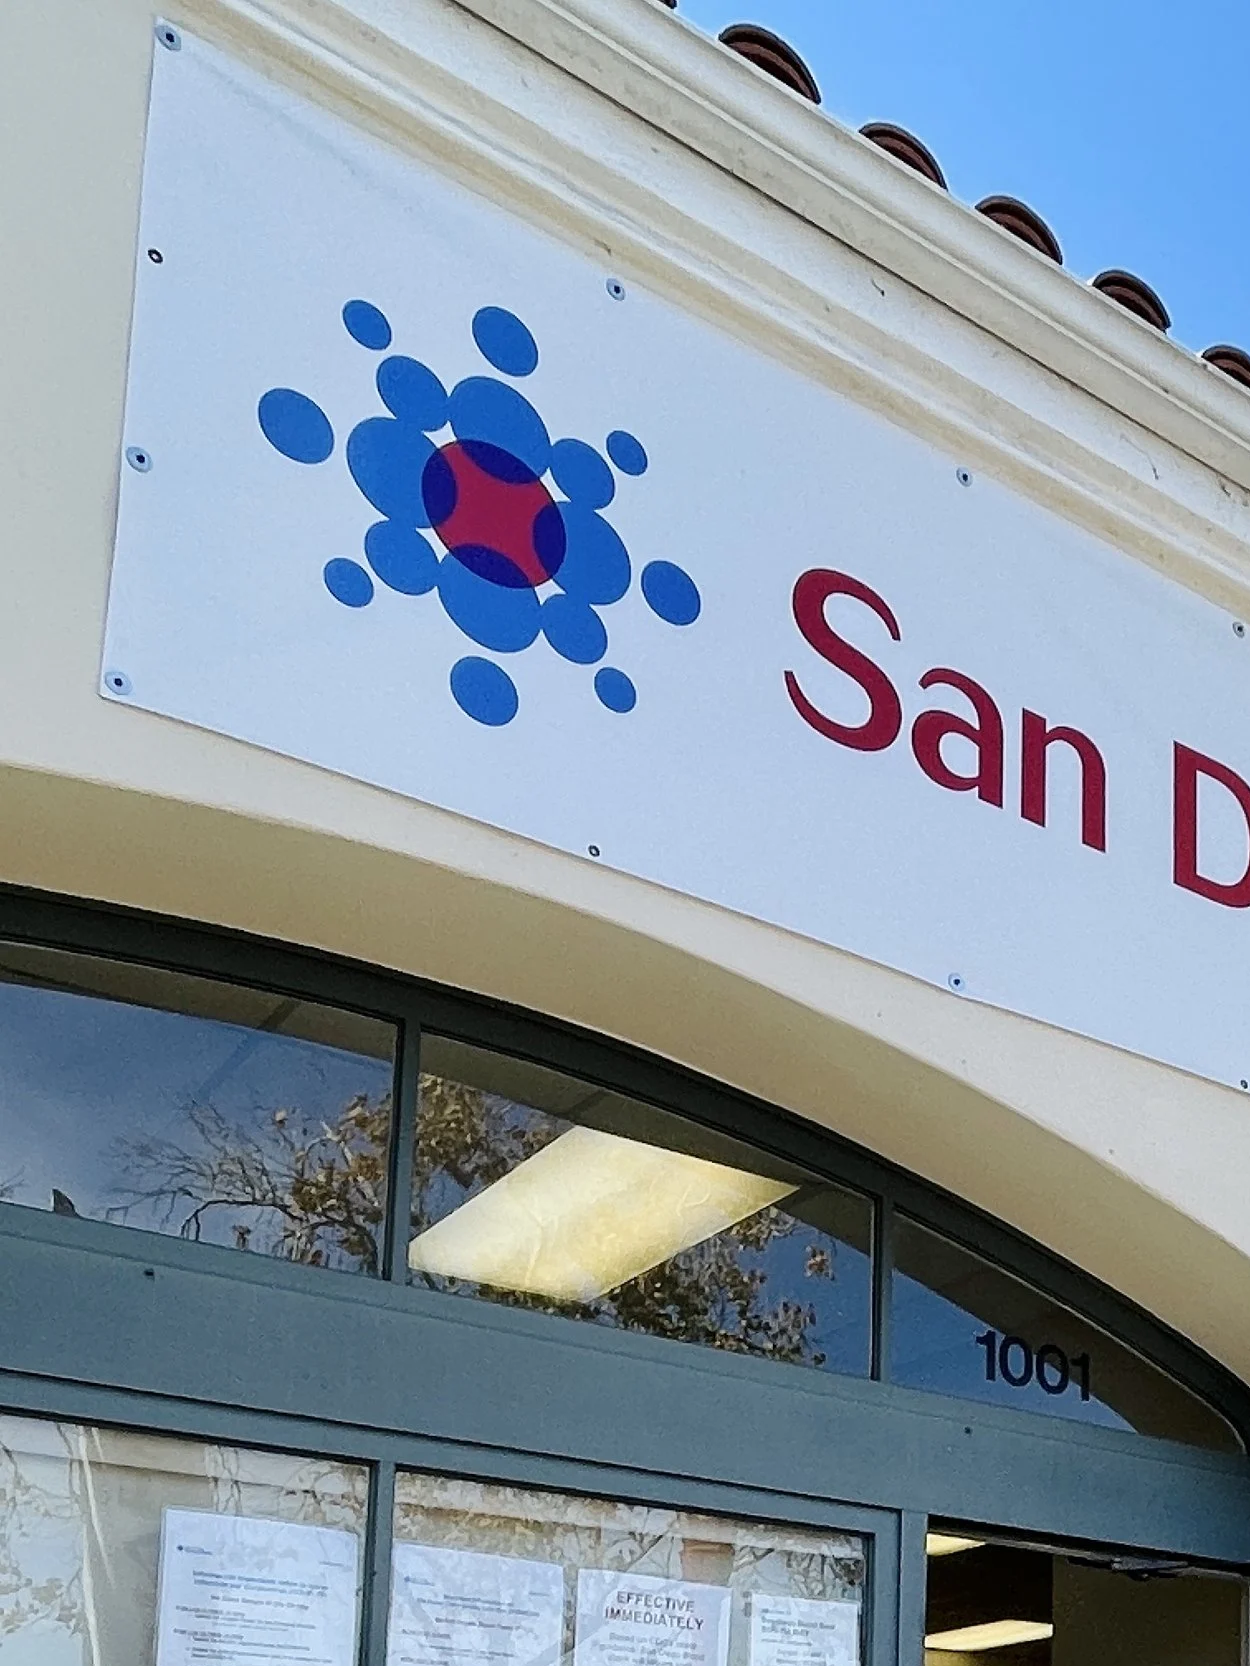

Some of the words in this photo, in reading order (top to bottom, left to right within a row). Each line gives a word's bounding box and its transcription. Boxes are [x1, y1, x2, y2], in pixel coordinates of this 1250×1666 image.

[784, 568, 1107, 854] San
[975, 1329, 1090, 1402] 1001
[604, 1606, 705, 1630] IMMEDIATELY
[616, 1590, 696, 1613] EFFECTIVE
